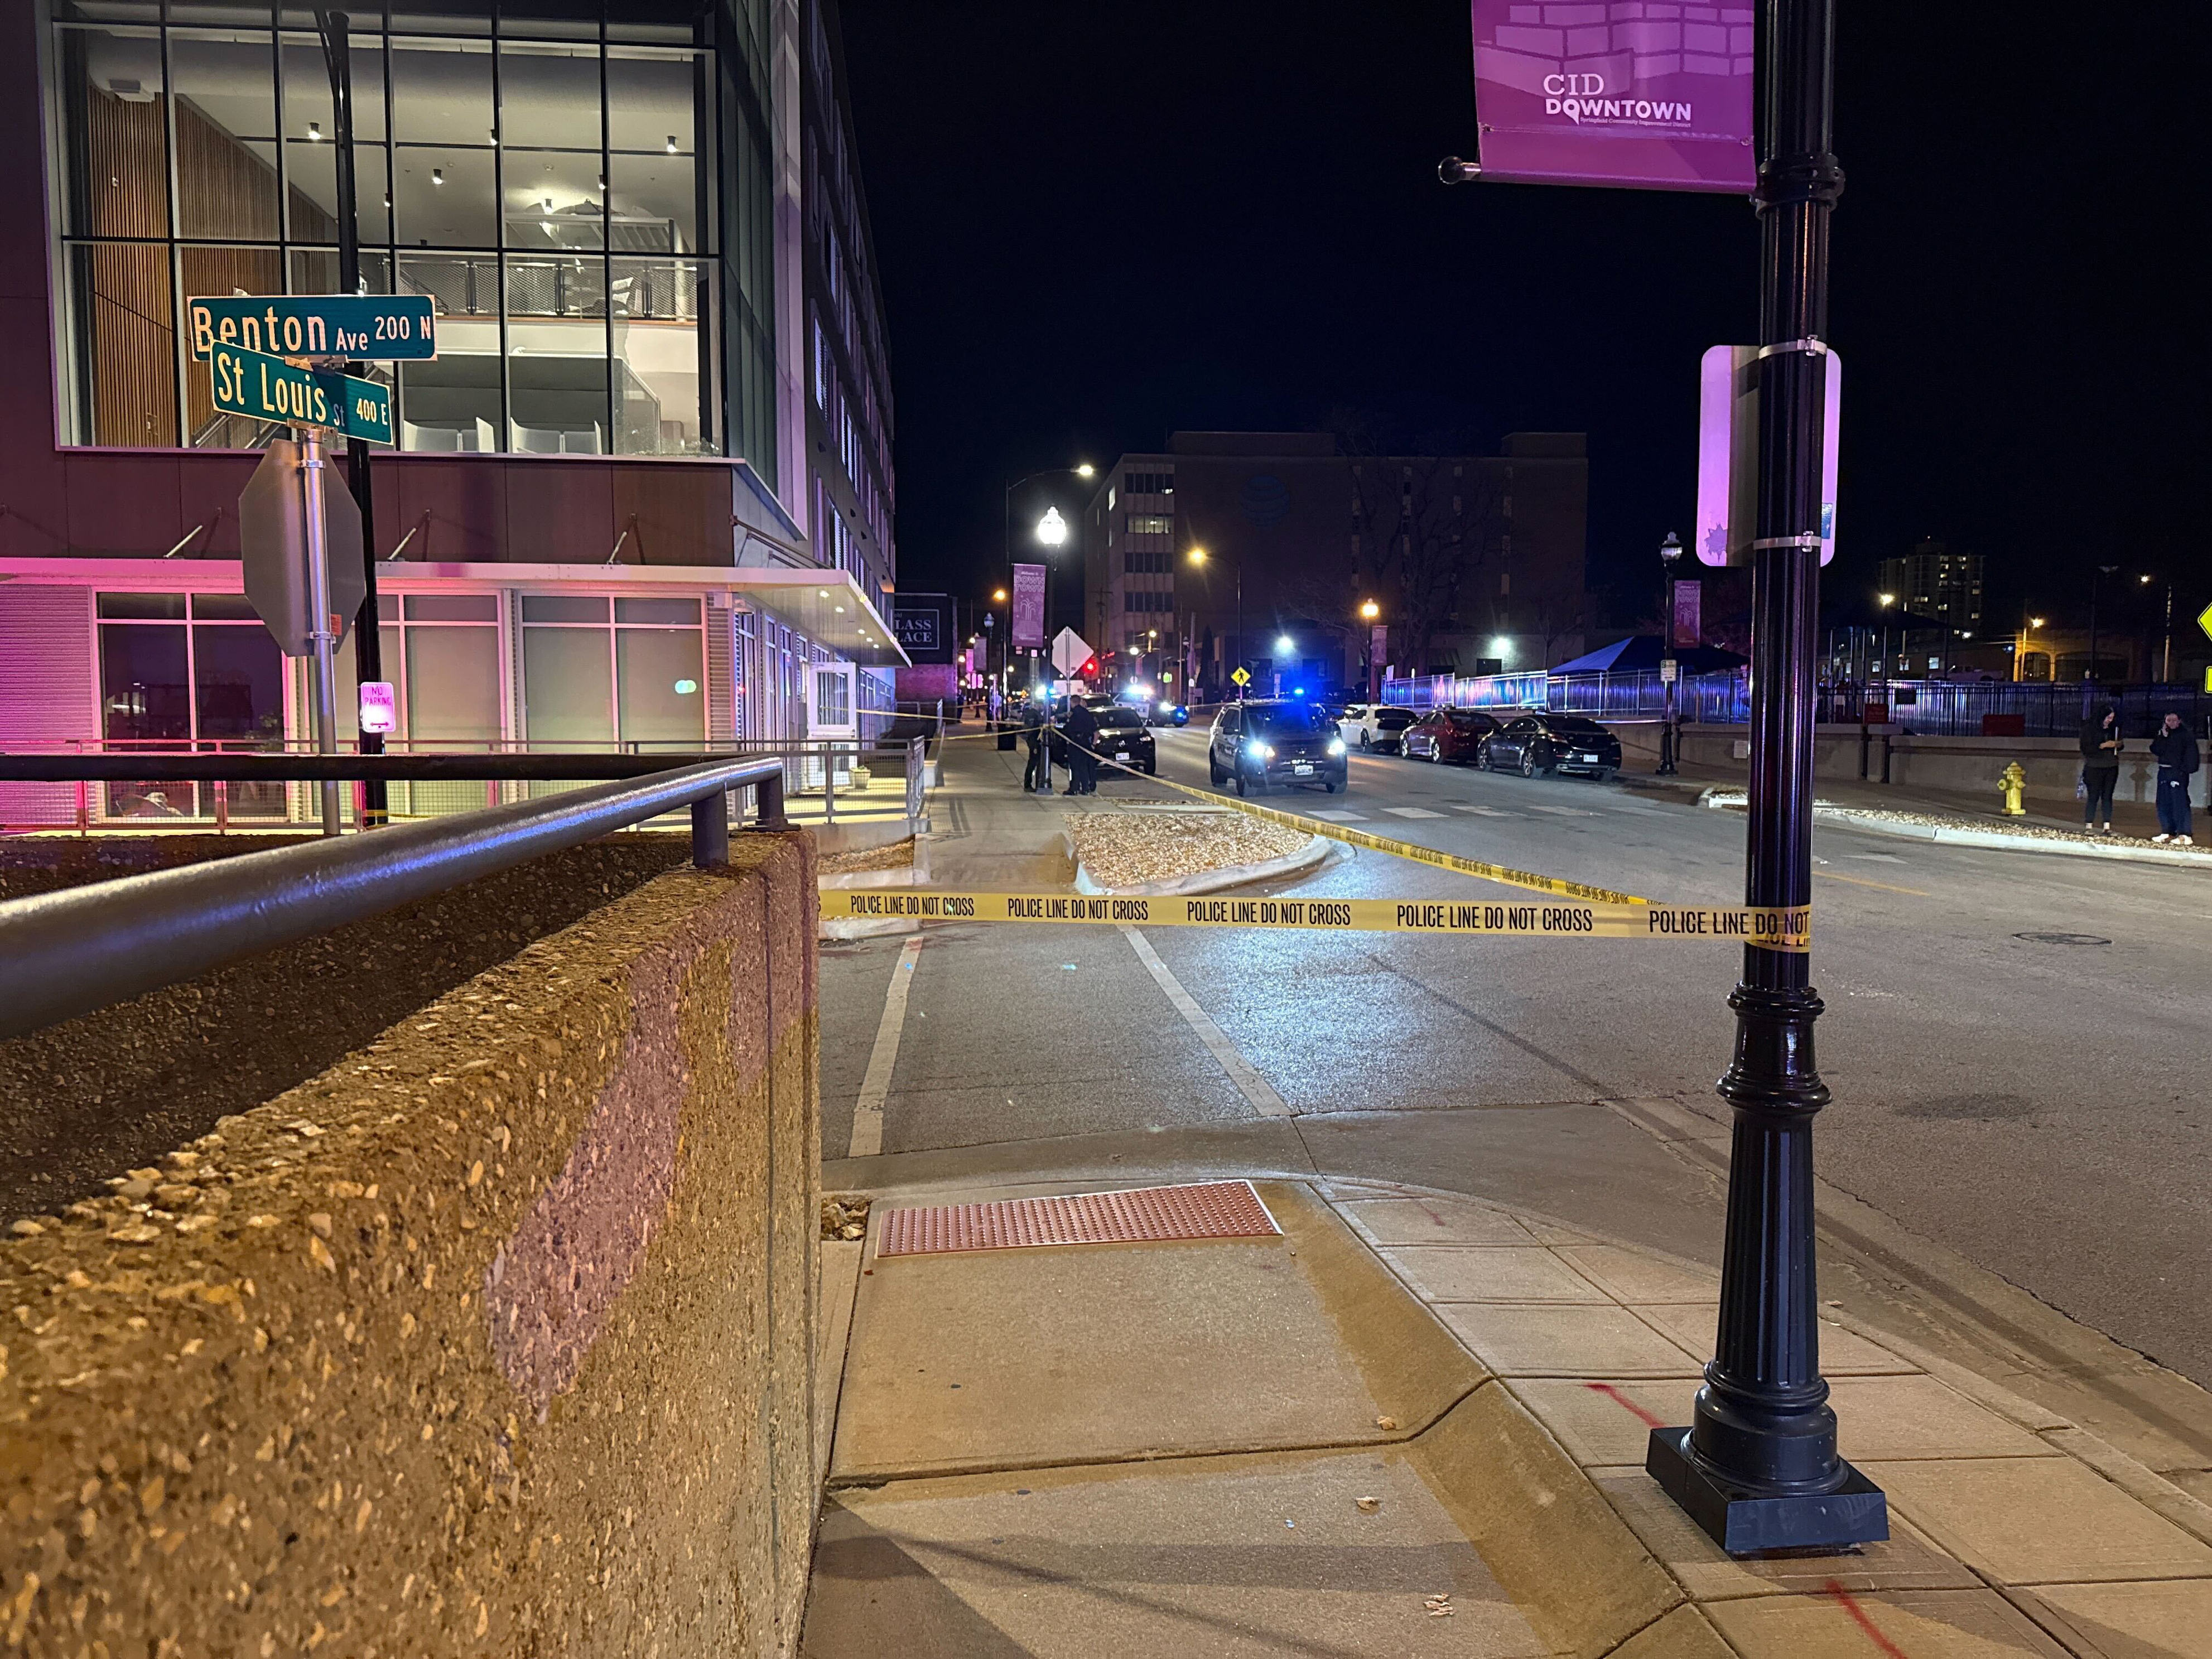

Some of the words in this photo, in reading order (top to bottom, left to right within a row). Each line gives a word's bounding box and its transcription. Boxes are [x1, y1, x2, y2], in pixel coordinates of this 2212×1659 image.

[1544, 74, 1604, 95] CID
[1545, 99, 1691, 125] DOWNTOWN
[193, 306, 326, 351] Benton
[336, 327, 368, 351] Ave
[375, 316, 410, 340] 200
[420, 316, 431, 339] N
[218, 353, 244, 405] St
[261, 363, 326, 422] Louis
[334, 403, 345, 427] St
[356, 398, 377, 423] 400
[381, 403, 388, 425] E
[1014, 575, 1045, 585] DOWN
[1014, 583, 1045, 592] TOWN
[894, 619, 932, 630] LASS
[894, 632, 932, 642] LACE
[364, 697, 391, 706] PARKING
[372, 687, 383, 696] NO
[851, 895, 881, 913] POLICE
[885, 896, 904, 914] LINE
[907, 897, 919, 914] DO
[922, 897, 939, 915] NOT
[943, 897, 974, 916] CROSS
[1008, 899, 1043, 918] POLICE
[1047, 899, 1068, 918] LINE
[1072, 899, 1085, 918] DO
[1089, 900, 1109, 919] NOT
[1113, 900, 1148, 920] CROSS
[1187, 901, 1227, 922] POLICE
[1231, 902, 1257, 923] LINE
[1261, 903, 1276, 923] DO
[1281, 903, 1304, 924] NOT
[1309, 904, 1350, 925] CROSS
[1397, 905, 1445, 928] POLICE
[1450, 906, 1480, 929] LINE
[1485, 907, 1503, 929] DO
[1509, 908, 1537, 930] NOT
[1543, 908, 1592, 931] CROSS
[1650, 910, 1707, 933] POLICE
[1713, 913, 1750, 934] LINE
[1755, 913, 1777, 934] DO
[1785, 911, 1809, 934] NOT
